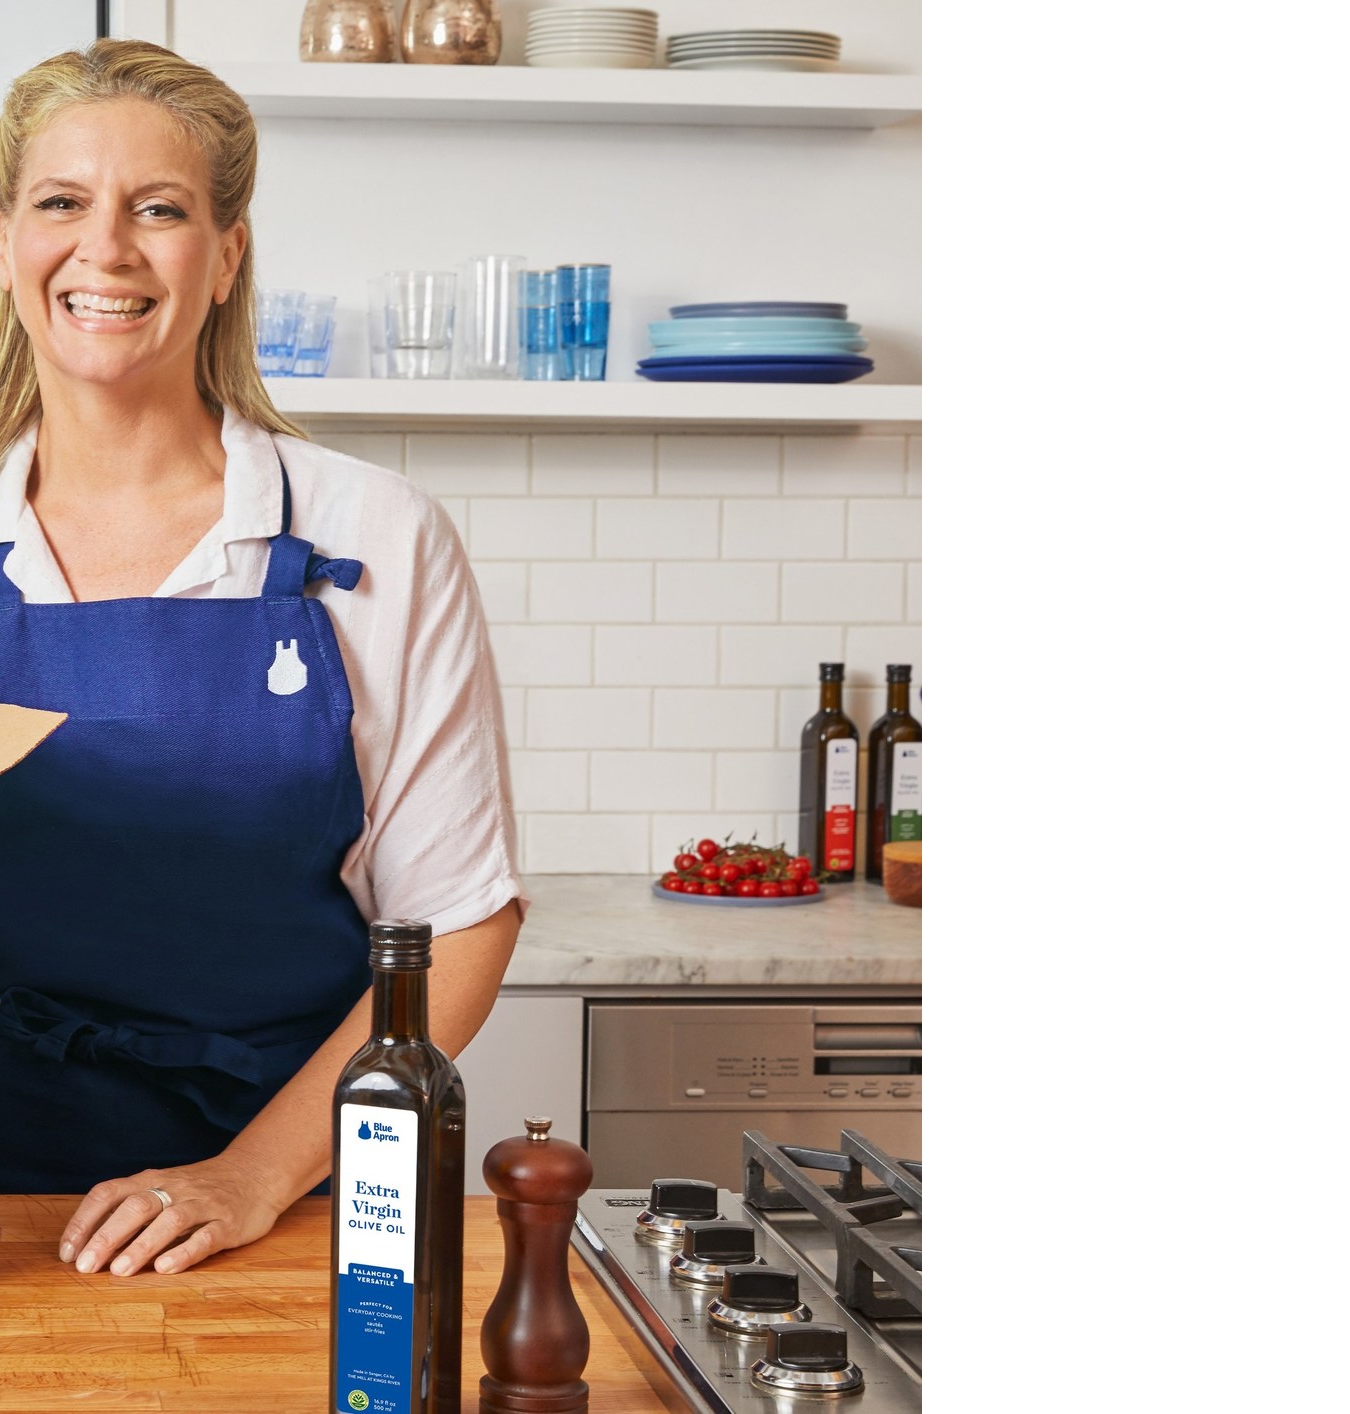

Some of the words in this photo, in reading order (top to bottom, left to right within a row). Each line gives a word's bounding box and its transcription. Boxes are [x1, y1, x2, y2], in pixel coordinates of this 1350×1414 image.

[373, 1122, 393, 1132] Blue
[373, 1132, 399, 1142] Apron
[355, 1180, 400, 1199] Extra
[351, 1199, 402, 1220] Virgin
[348, 1219, 382, 1232] OLIVE
[386, 1224, 406, 1235] OIL
[353, 1268, 391, 1278] BALANCED
[356, 1276, 395, 1287] VERSATILE
[348, 1307, 375, 1316] EVERYDAY
[376, 1312, 403, 1321] COOKING
